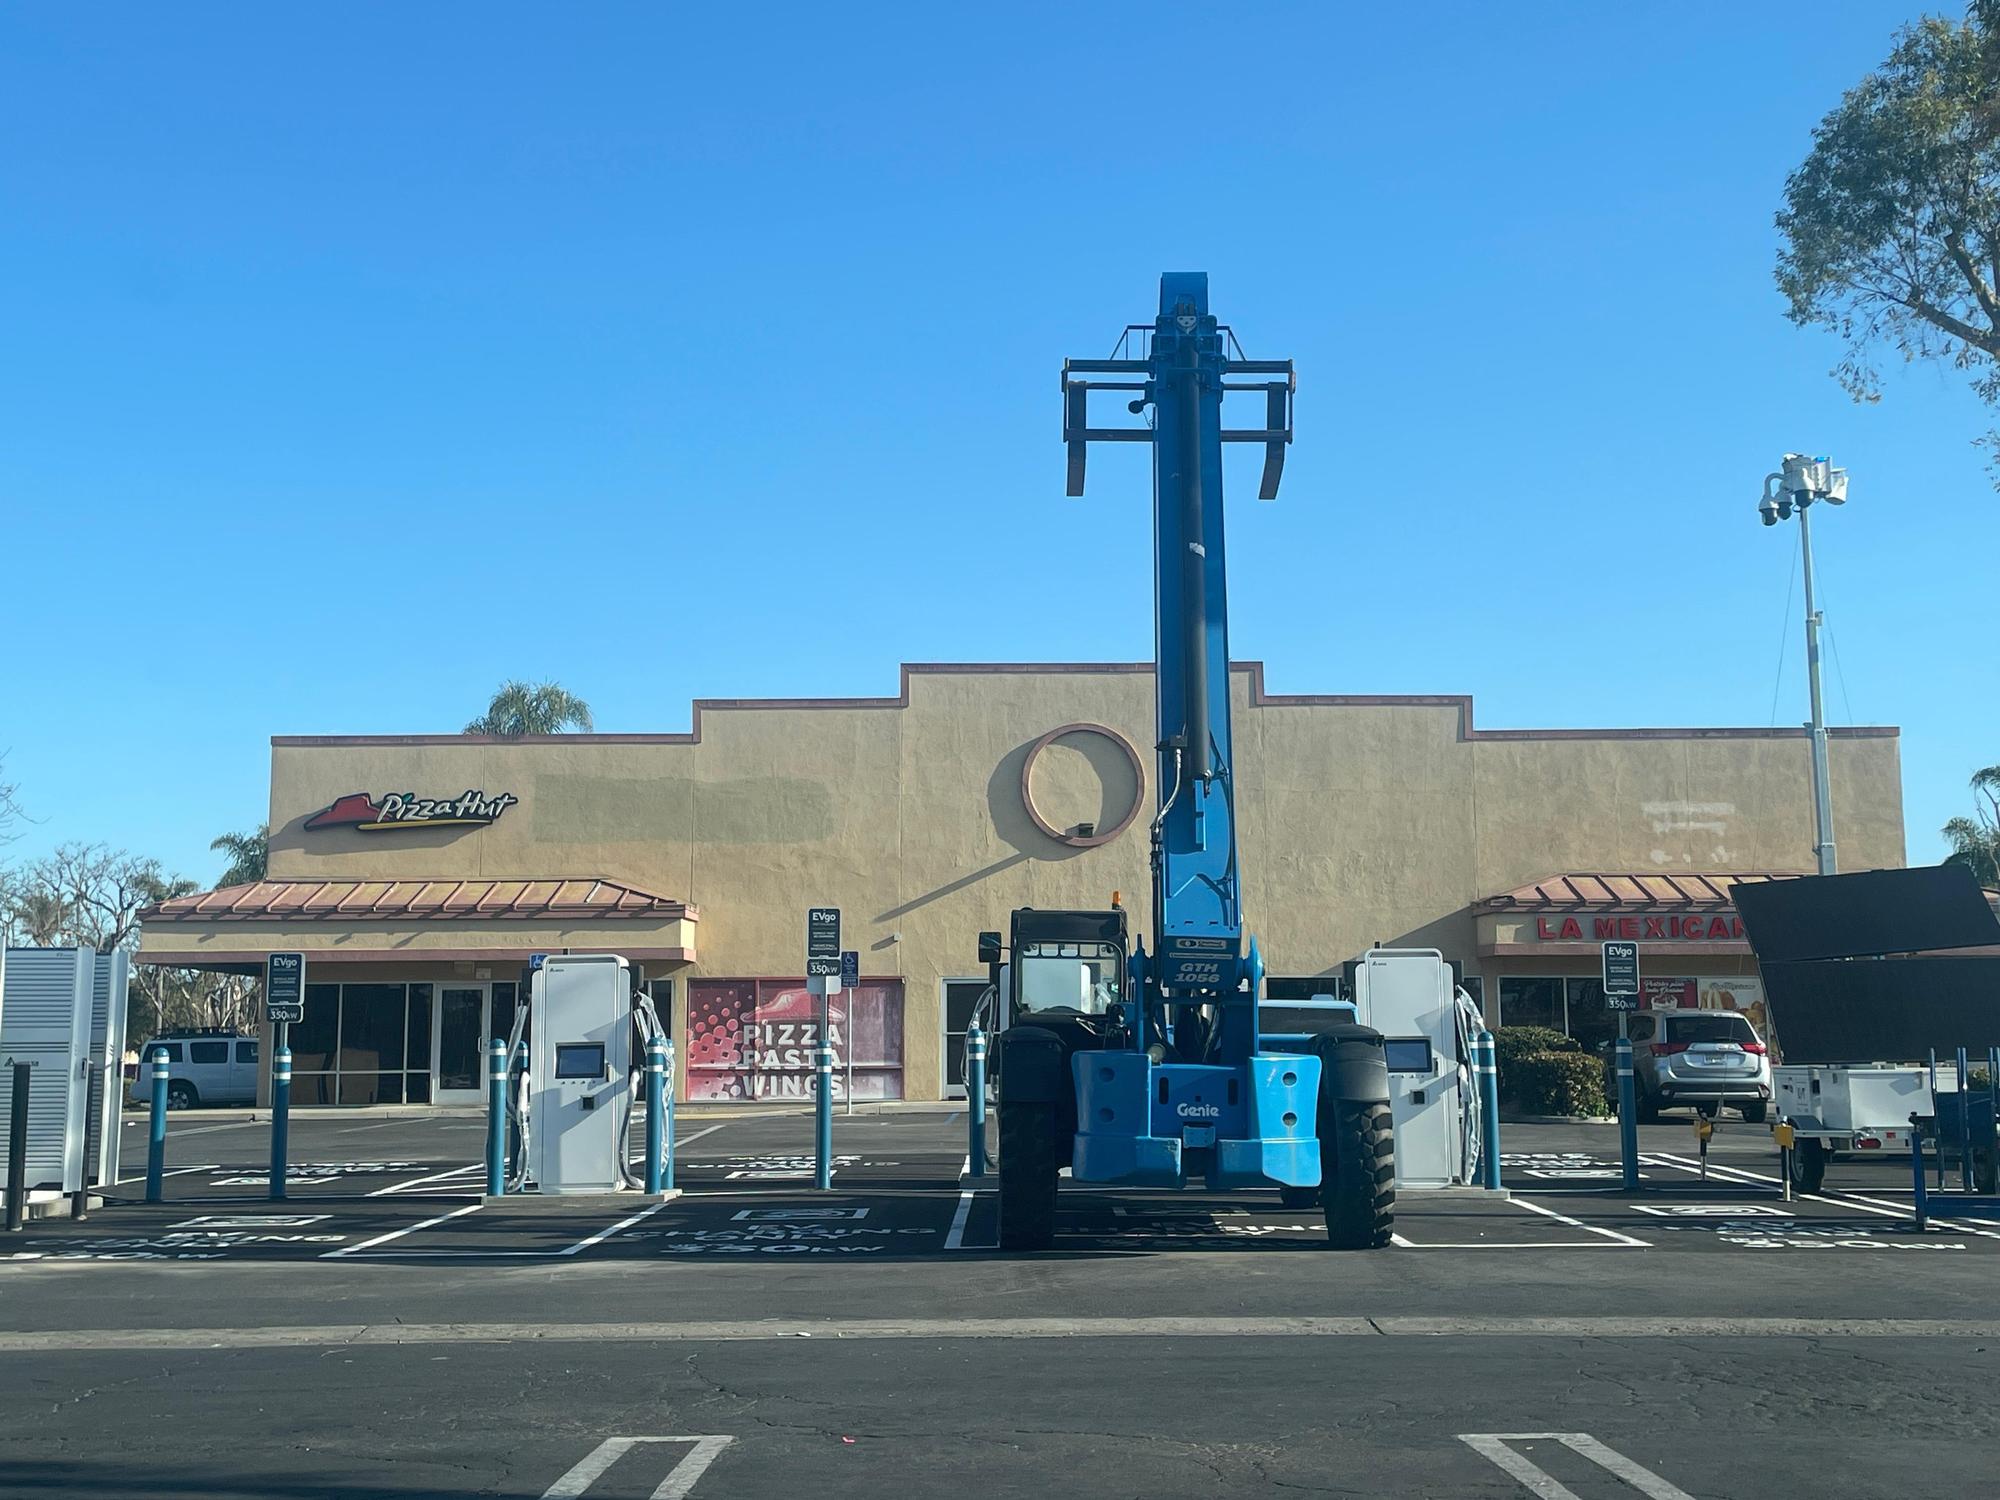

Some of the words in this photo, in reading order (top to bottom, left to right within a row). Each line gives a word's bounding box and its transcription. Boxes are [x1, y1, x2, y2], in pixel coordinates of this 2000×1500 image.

[376, 792, 452, 823] Pizza
[454, 789, 518, 817] Hut
[812, 912, 837, 923] EVgo
[1537, 916, 1582, 940] LA
[1608, 946, 1633, 958] EVgo
[273, 957, 298, 969] EVgo
[1180, 962, 1219, 973] GTH
[1174, 973, 1221, 983] 1056
[743, 1024, 843, 1045] PIZZA
[743, 1049, 842, 1069] PASTA
[1176, 1103, 1220, 1117] Genie
